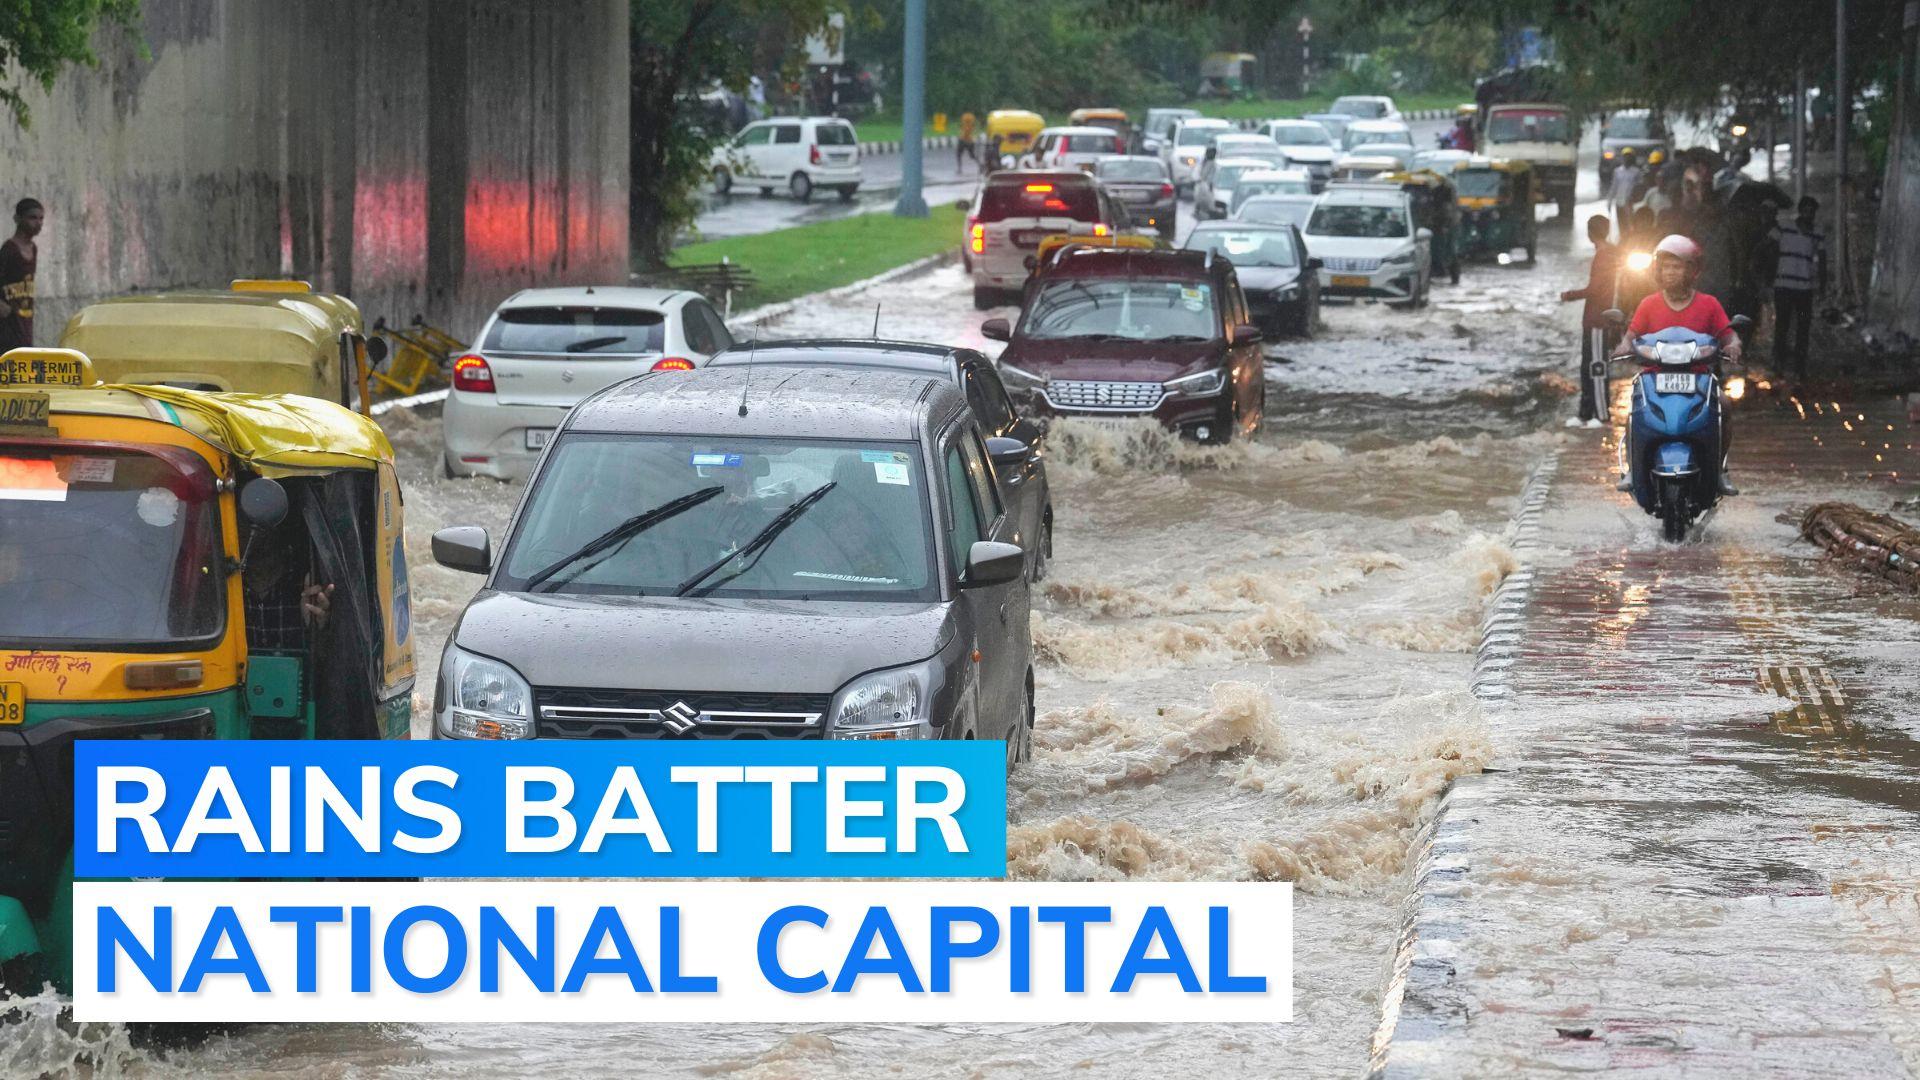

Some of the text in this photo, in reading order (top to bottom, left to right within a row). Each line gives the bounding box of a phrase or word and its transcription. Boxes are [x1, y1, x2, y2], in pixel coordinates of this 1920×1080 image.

[0, 361, 80, 374] NCR PERMIT
[0, 374, 41, 384] DELH
